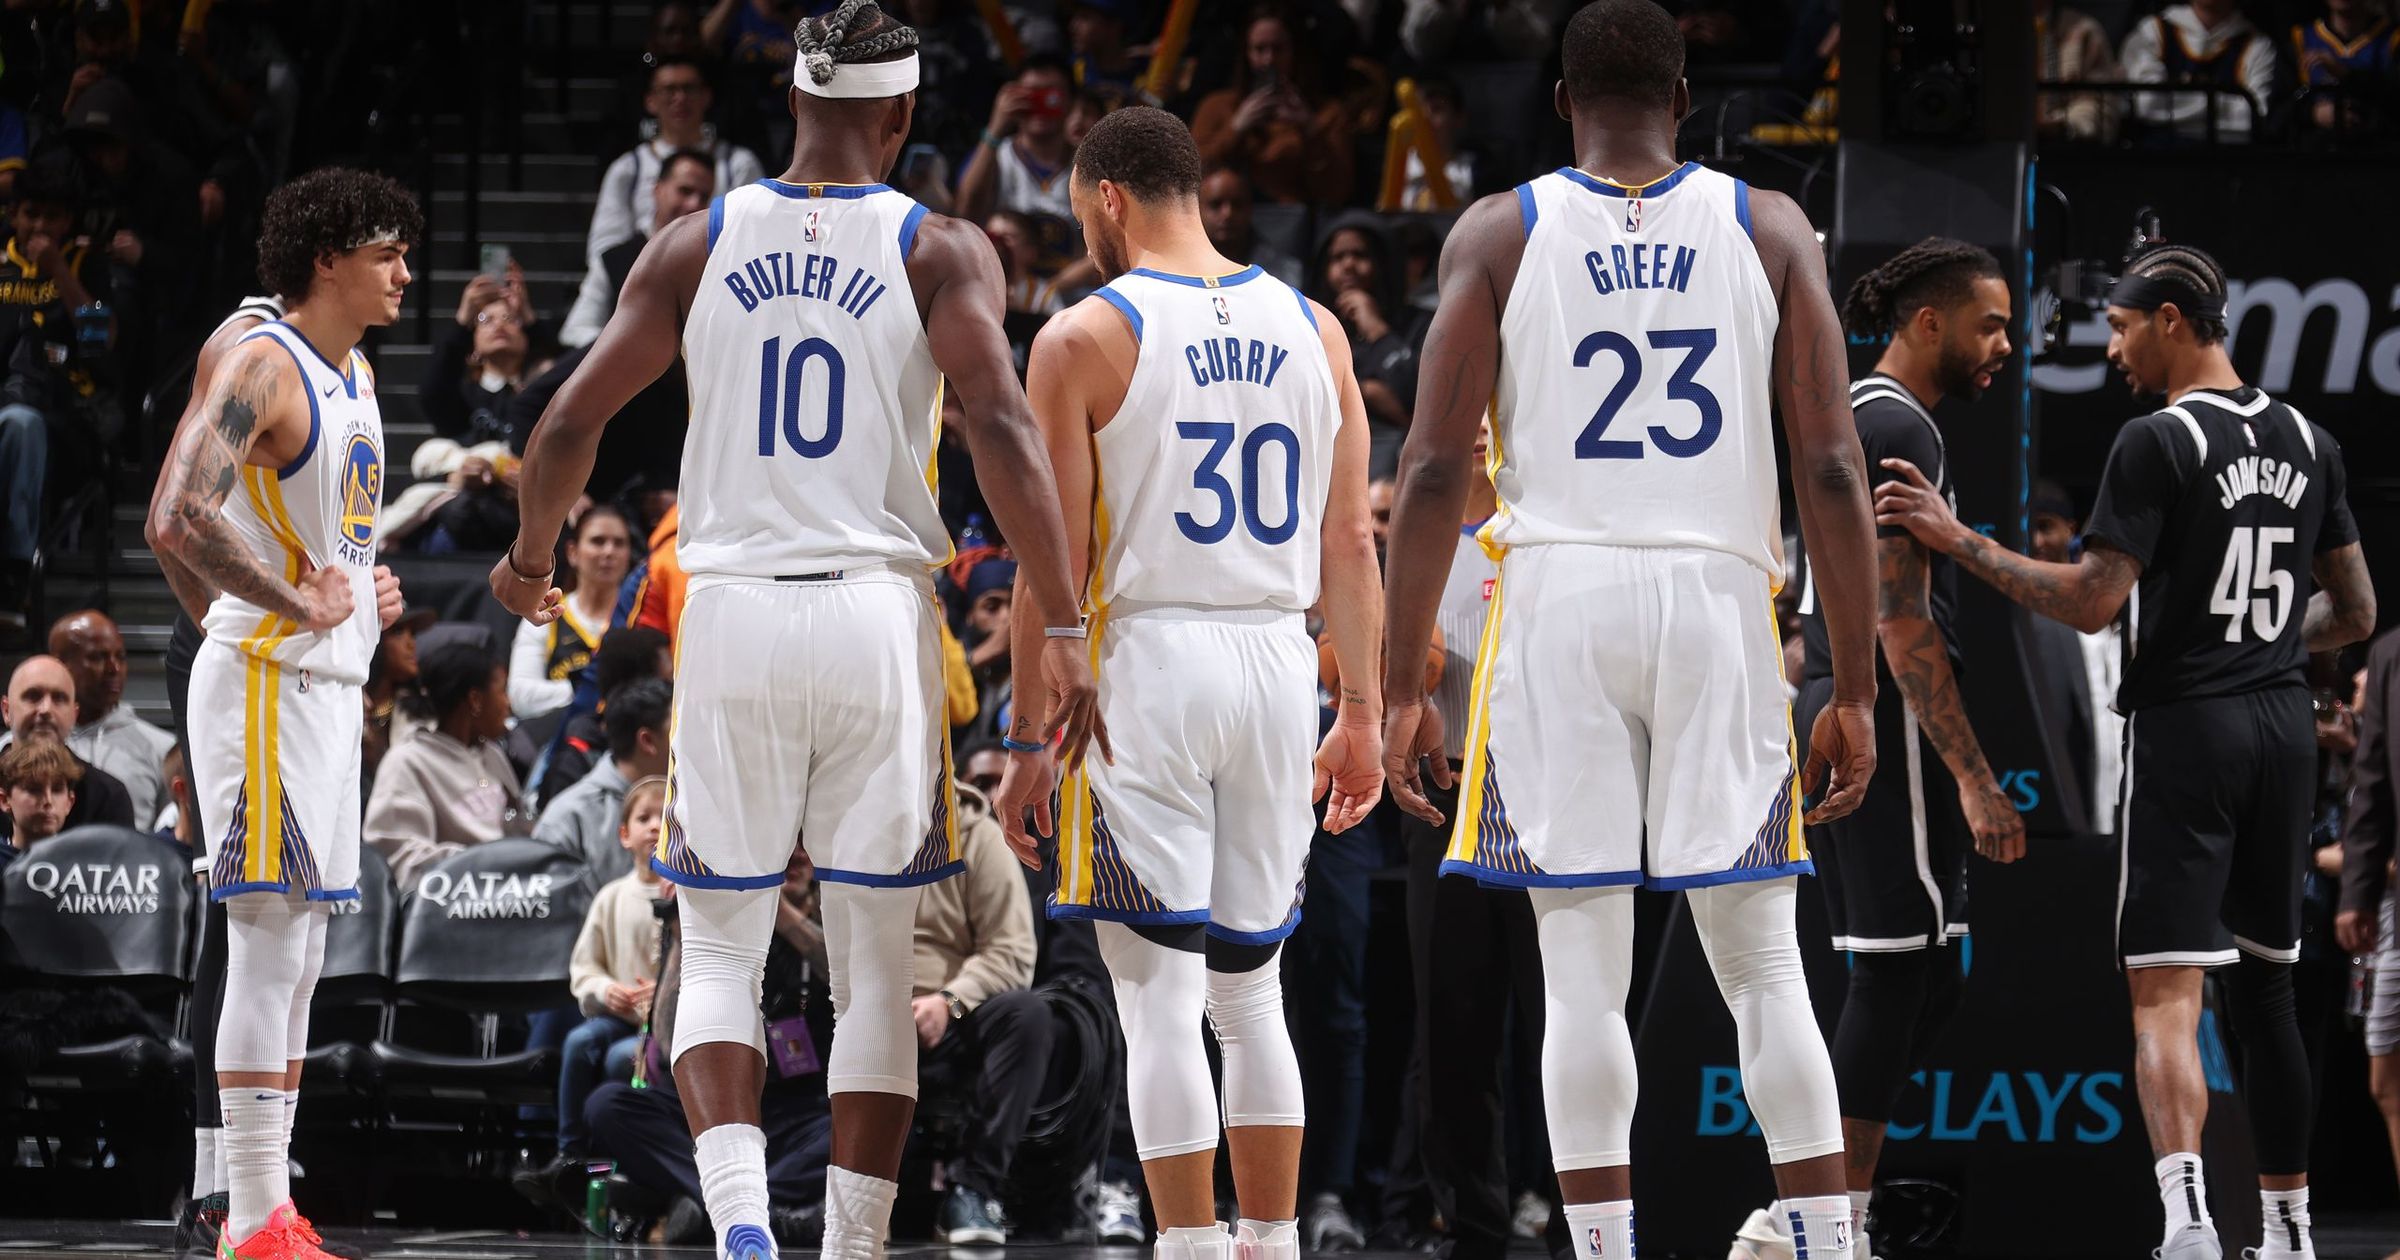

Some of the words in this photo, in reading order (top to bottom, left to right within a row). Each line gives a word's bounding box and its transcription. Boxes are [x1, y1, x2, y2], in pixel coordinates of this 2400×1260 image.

[723, 252, 838, 313] BUTLER
[837, 267, 887, 320] III
[1585, 244, 1697, 295] GREEN
[1185, 337, 1289, 388] CURRY
[758, 336, 846, 458] 10
[1573, 328, 1723, 459] 23
[340, 418, 360, 456] GOLDEN
[367, 463, 378, 494] 15
[1174, 422, 1301, 545] 30
[2215, 455, 2309, 510] JOHNSON
[2209, 526, 2295, 643] 45
[26, 861, 161, 899] QATAR
[57, 893, 159, 914] AIRWAYS
[418, 870, 553, 907] QATAR
[447, 900, 551, 919] AIRWAYS
